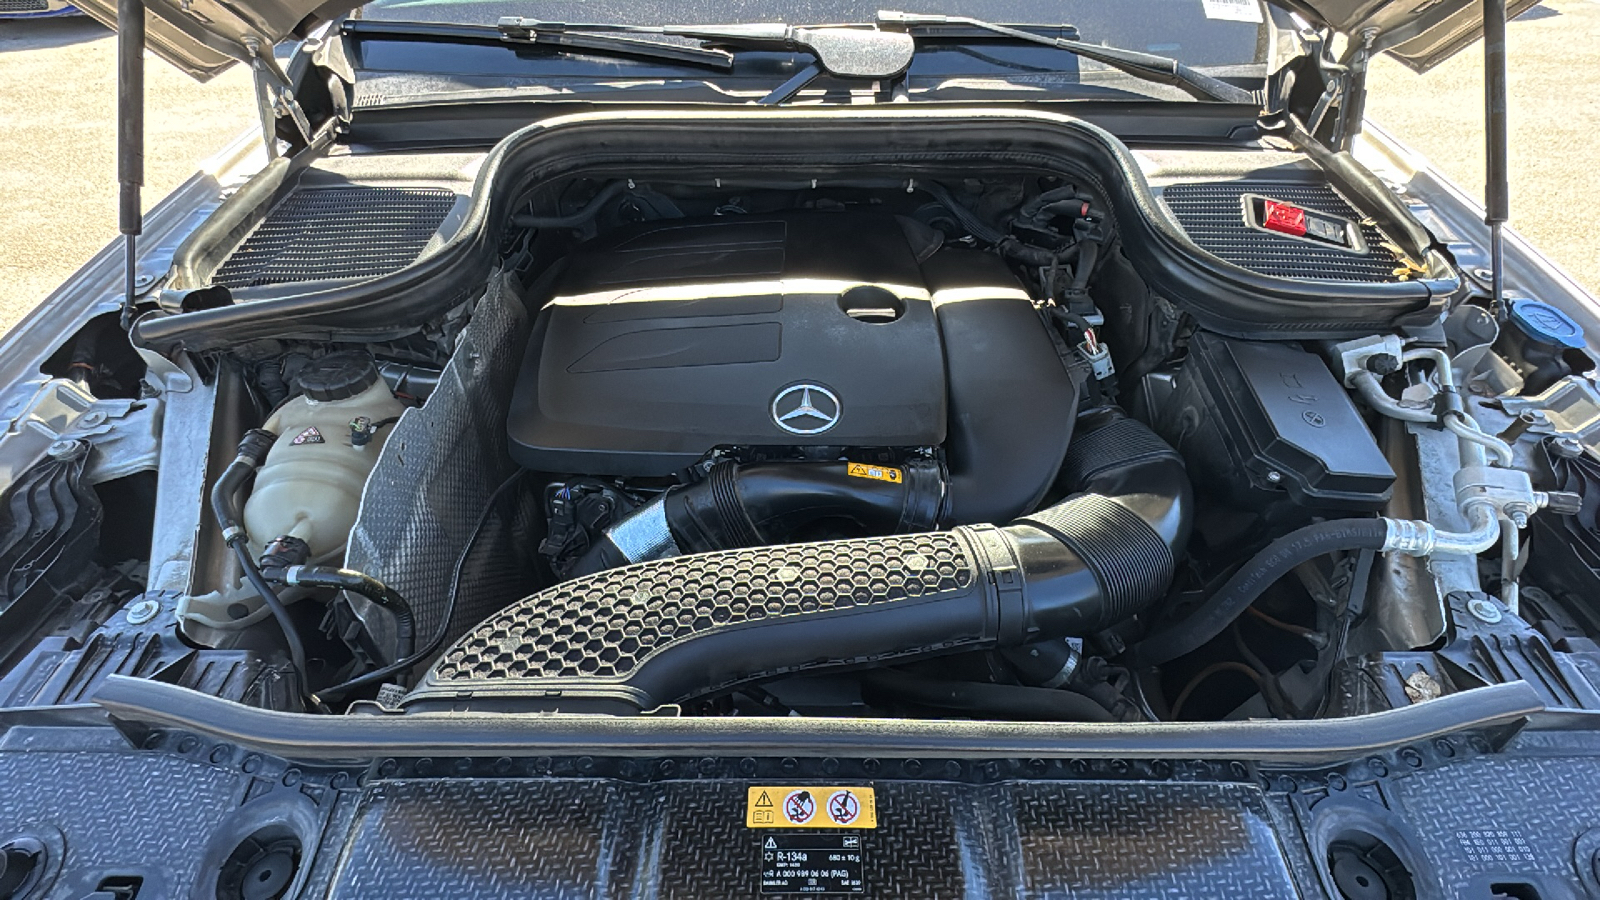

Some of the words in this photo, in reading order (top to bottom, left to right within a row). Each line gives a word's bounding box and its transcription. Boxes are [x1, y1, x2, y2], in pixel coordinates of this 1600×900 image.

[776, 852, 808, 862] R-134a
[776, 870, 782, 878] A
[782, 870, 796, 878] 000
[810, 870, 819, 878] 06
[820, 870, 829, 878] 06
[830, 870, 848, 878] (PAG)
